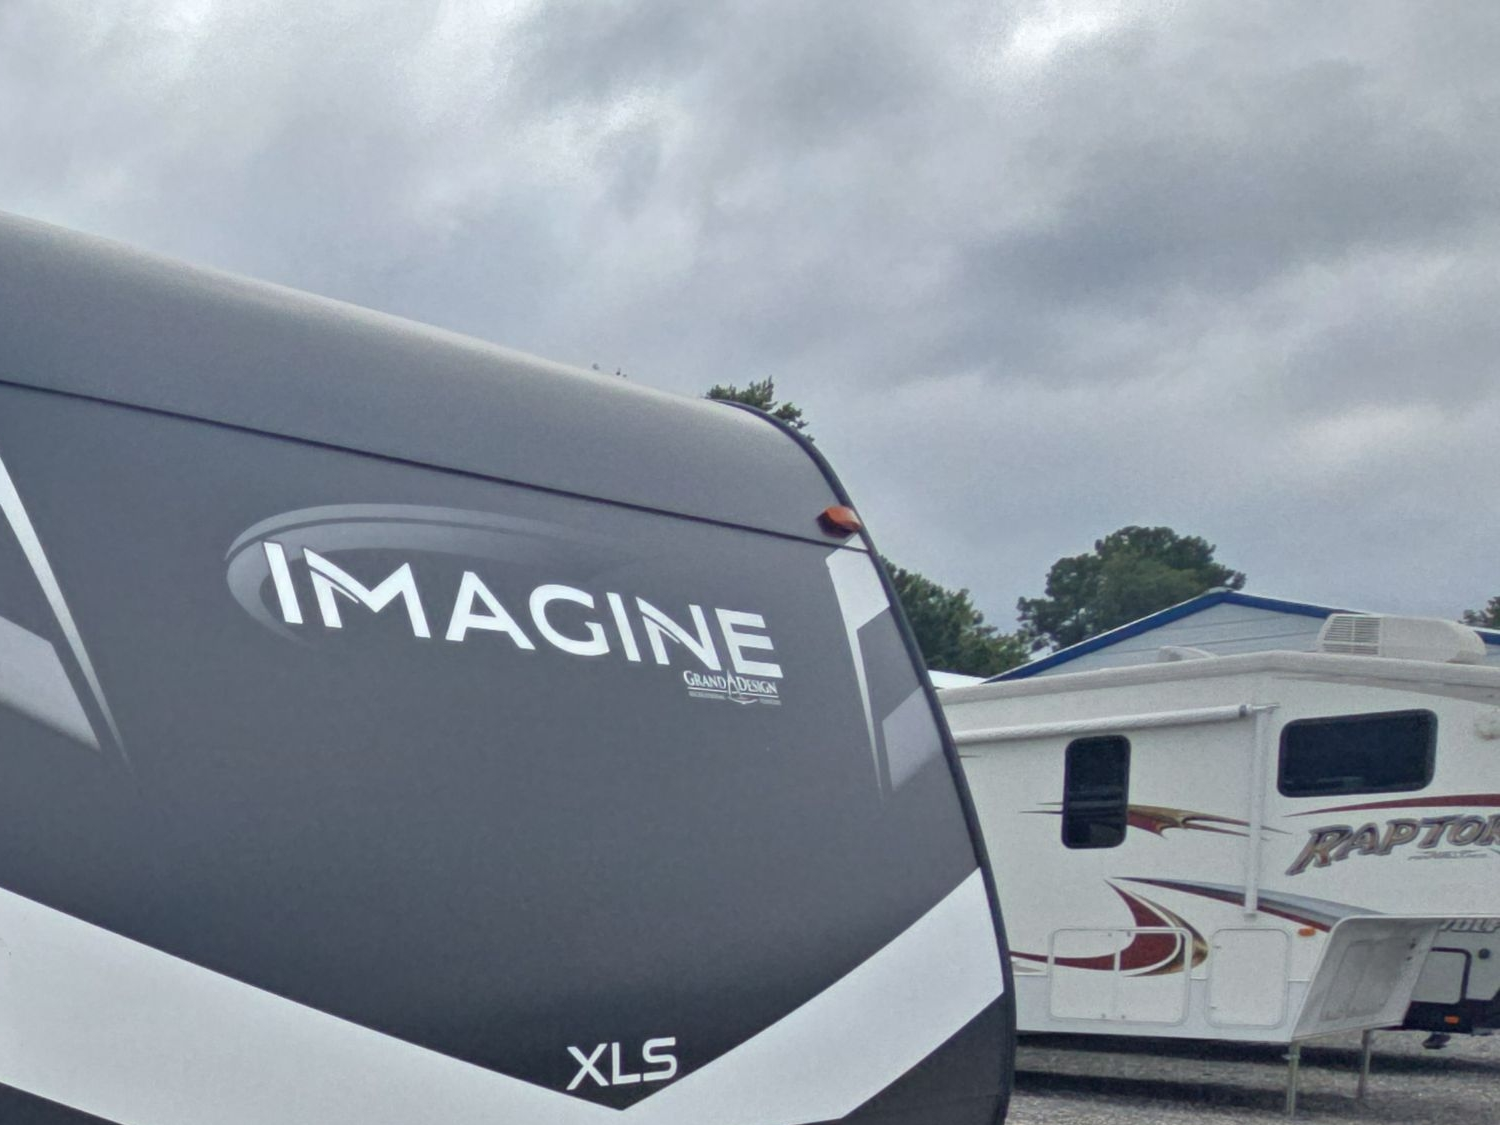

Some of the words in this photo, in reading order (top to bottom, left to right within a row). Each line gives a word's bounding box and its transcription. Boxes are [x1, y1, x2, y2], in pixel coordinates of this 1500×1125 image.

[261, 541, 783, 679] IMAGINE
[683, 669, 727, 689] GRAND
[736, 676, 778, 694] DESIGN
[566, 1036, 678, 1091] XLS
